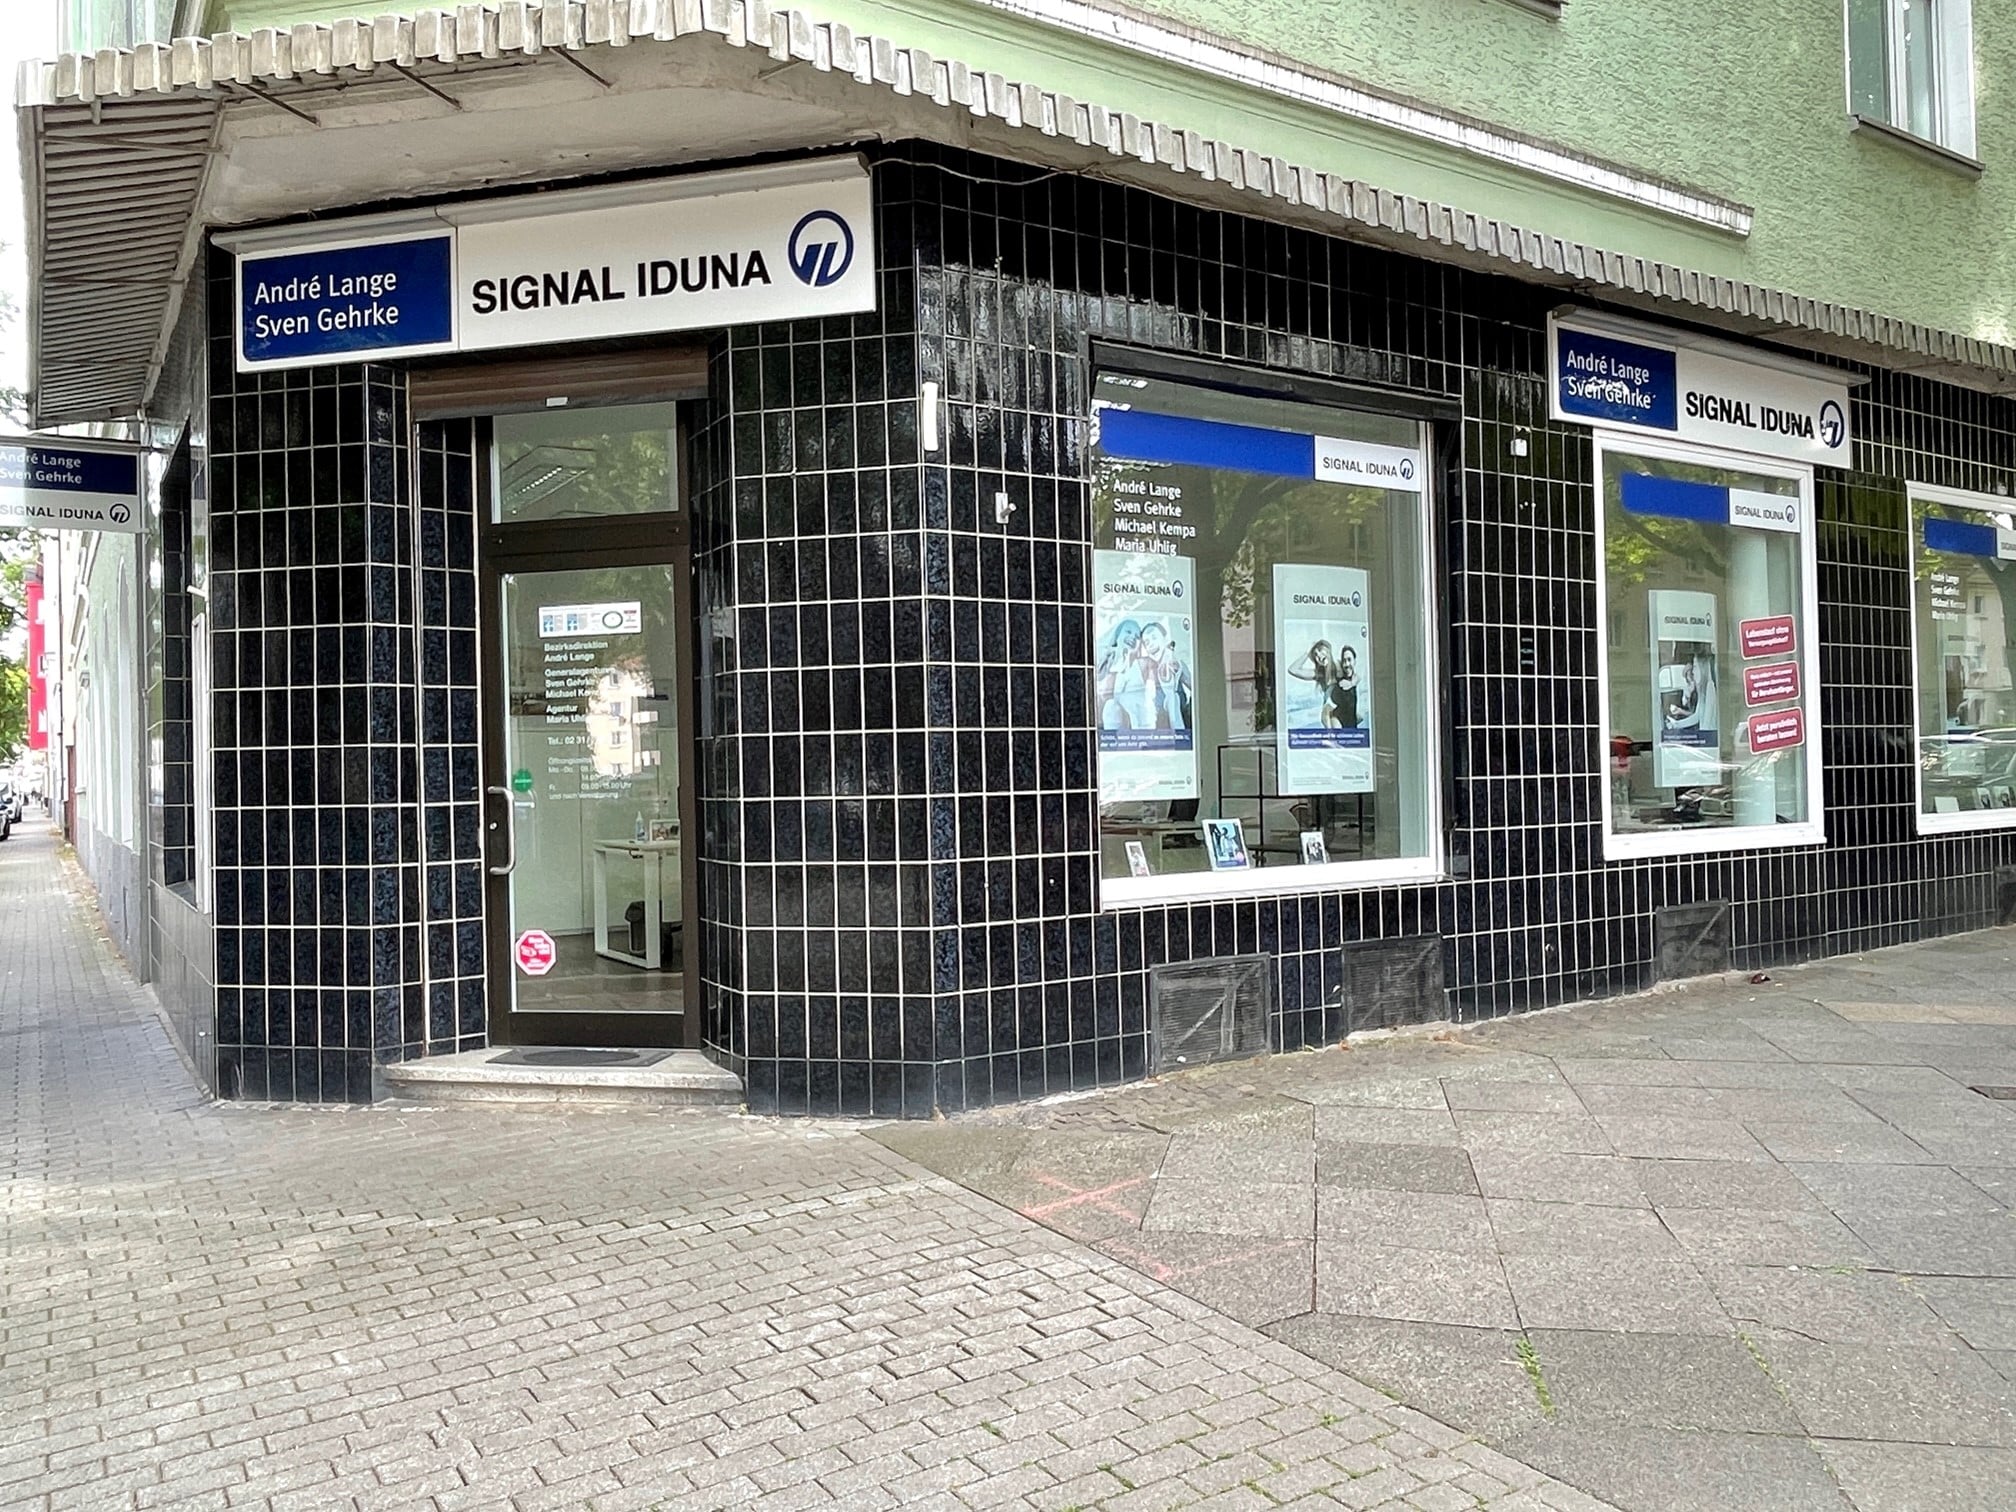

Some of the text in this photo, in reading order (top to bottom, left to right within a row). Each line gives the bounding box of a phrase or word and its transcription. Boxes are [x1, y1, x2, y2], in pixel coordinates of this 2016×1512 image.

[254, 272, 397, 305] André Lange
[471, 249, 772, 315] SIGNAL IDUNA
[255, 301, 399, 338] Sven Gehrke
[1566, 349, 1650, 385] André Lange
[1567, 376, 1651, 409] Sven Gehrke
[1685, 391, 1815, 440] SIGNAL IDUNA
[0, 452, 82, 469] André Lange
[1322, 456, 1398, 478] SIGNAL IDUNA
[0, 468, 83, 484] Sven Gehrke
[1113, 478, 1182, 500] André Lange
[0, 504, 105, 521] SIGNAL IDUNA
[1113, 498, 1182, 517] Sven Gehrke
[1734, 505, 1784, 521] SIGNAL IDUNA
[1114, 517, 1196, 539] Michael Kempa
[1115, 537, 1177, 556] Maria Uhlig
[1103, 583, 1171, 595] SIGNAL IDUNA
[1293, 594, 1351, 605] SIGNAL IDUNA
[544, 652, 595, 663] André Lange
[546, 705, 578, 715] Agentur
